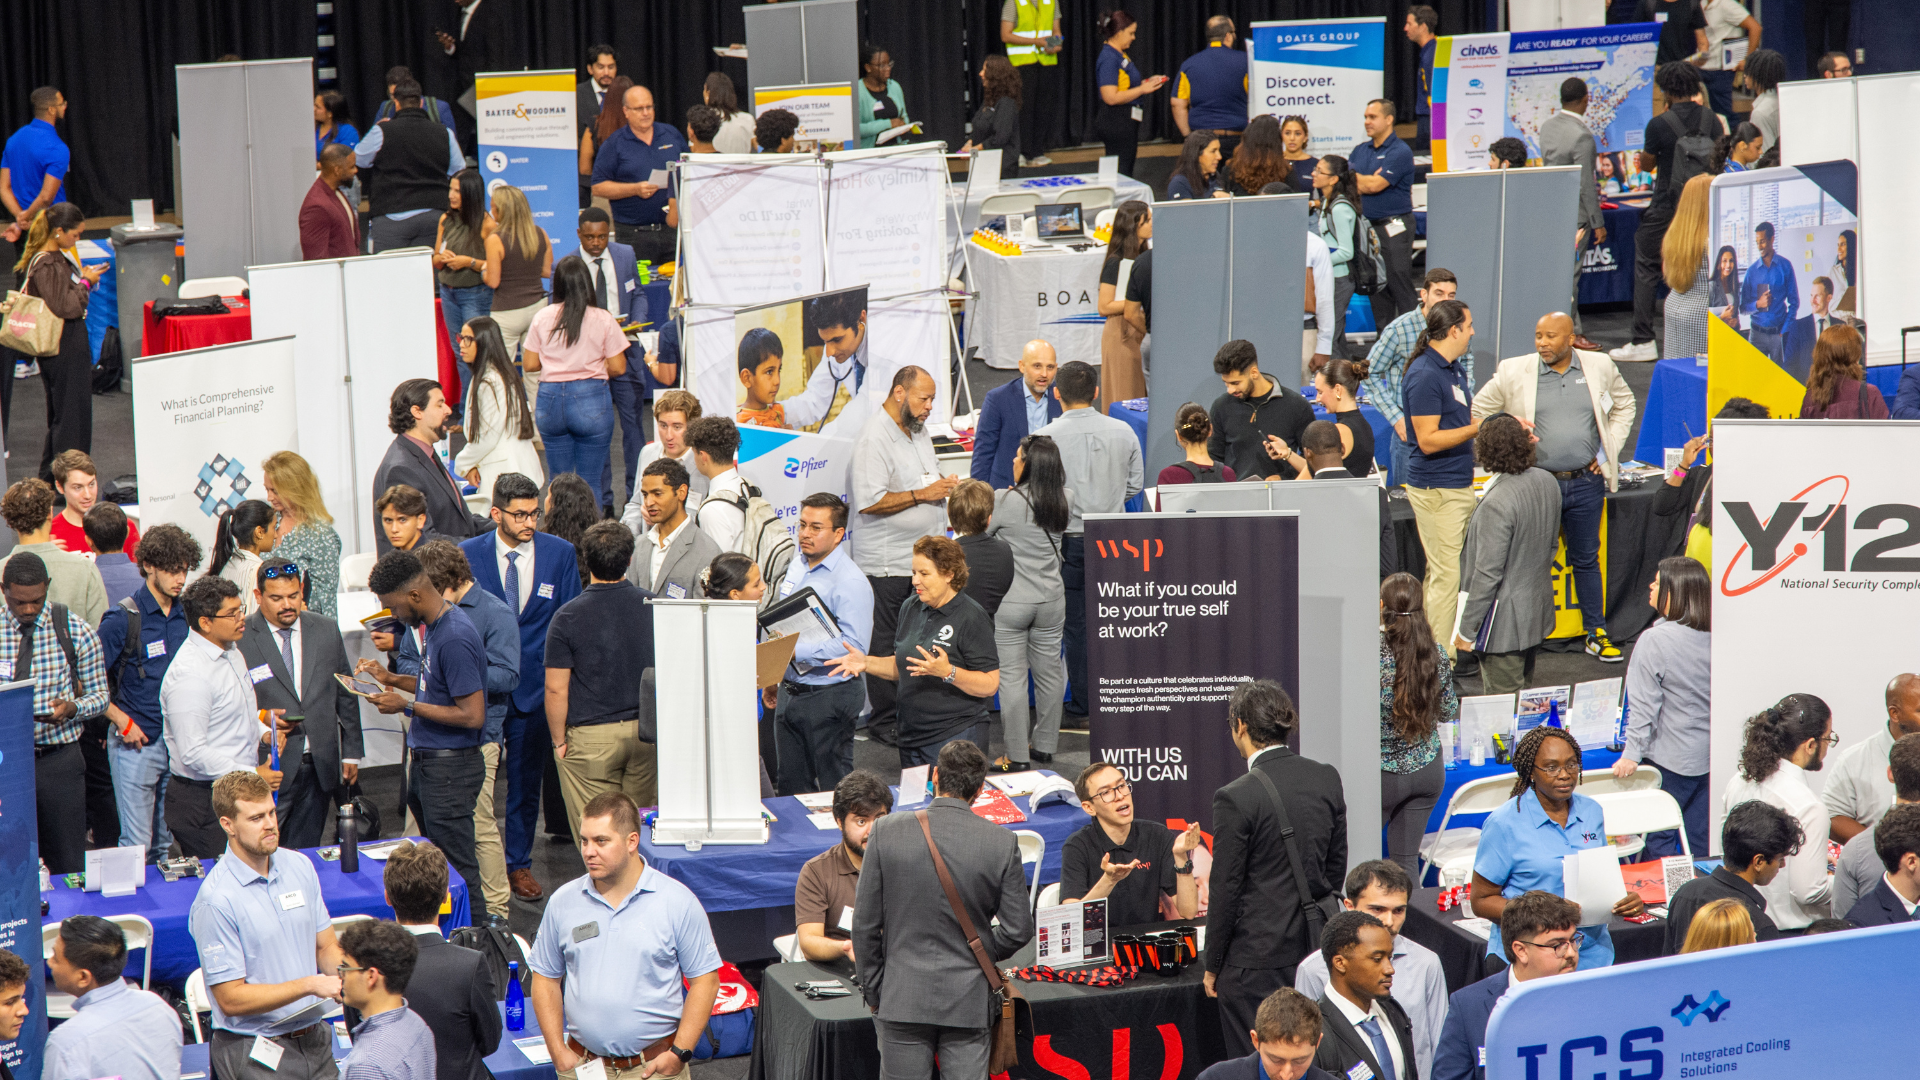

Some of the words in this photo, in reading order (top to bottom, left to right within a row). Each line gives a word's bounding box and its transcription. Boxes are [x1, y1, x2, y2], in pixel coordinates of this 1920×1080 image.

[1277, 34, 1315, 43] BOATS
[1320, 32, 1360, 41] GROUP
[1514, 42, 1531, 50] ARE
[1532, 41, 1549, 49] YOU
[1550, 38, 1578, 48] READY
[1581, 37, 1598, 45] FOR
[1598, 34, 1619, 44] YOUR
[1620, 32, 1653, 42] CAREER?
[1266, 76, 1335, 89] Discover.
[1266, 93, 1335, 107] Connect.
[486, 109, 516, 117] BAXTER
[515, 103, 530, 122] &
[525, 107, 566, 115] WOODMAN
[161, 398, 188, 411] What
[190, 396, 198, 407] is
[199, 384, 275, 405] Comprehensive
[174, 408, 215, 425] Financial
[217, 400, 264, 417] Planning?
[801, 457, 828, 478] Pfizer
[149, 493, 176, 503] Personal
[775, 505, 798, 519] e're
[1096, 539, 1164, 572] wsp
[1098, 582, 1142, 598] What
[1145, 581, 1155, 597] if
[1157, 584, 1188, 600] you
[1191, 580, 1237, 596] could
[1781, 578, 1829, 589] National
[1832, 578, 1878, 592] Security
[1098, 603, 1120, 618] be
[1122, 605, 1160, 621] your
[1163, 602, 1196, 617] true
[1200, 600, 1229, 616] self
[1098, 623, 1114, 638] at
[1117, 622, 1168, 638] work?
[1110, 678, 1125, 686] part
[1178, 676, 1214, 684] celebrates
[1100, 687, 1136, 695] empowers
[1155, 686, 1198, 694] perspectives
[1112, 696, 1146, 704] champion
[1147, 695, 1186, 703] authenticity
[1201, 694, 1228, 702] support
[1120, 705, 1135, 713] step
[1101, 748, 1150, 764] WITH
[1156, 747, 1182, 763] US
[1116, 766, 1142, 782] OU
[1147, 765, 1188, 781] CAN
[0, 918, 28, 931] projects
[1680, 1044, 1743, 1063] Integrated
[1746, 1038, 1791, 1056] Cooling
[1680, 1061, 1738, 1078] Solutions
